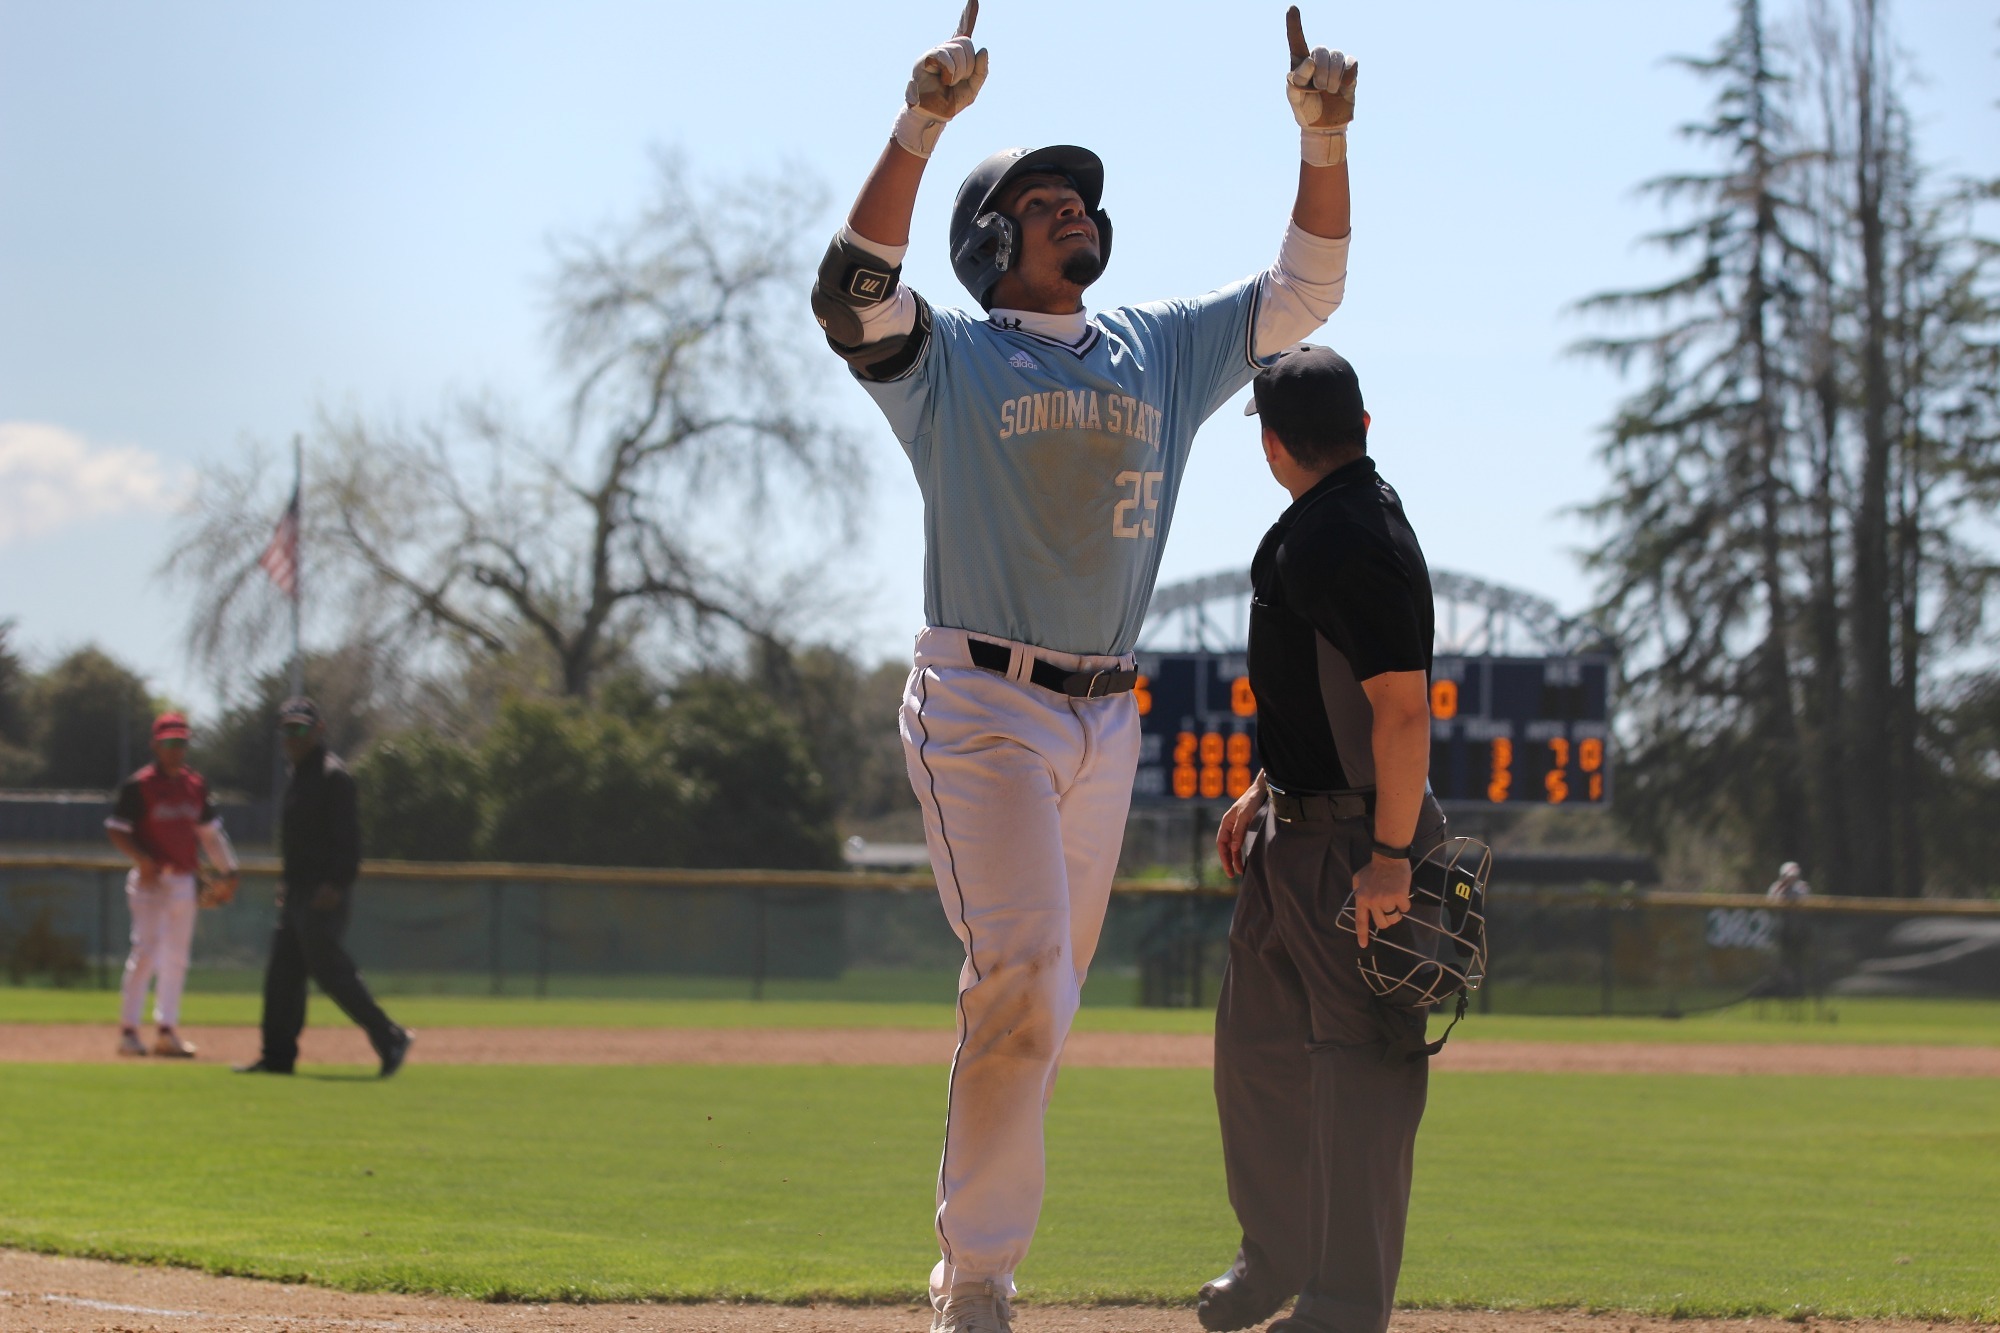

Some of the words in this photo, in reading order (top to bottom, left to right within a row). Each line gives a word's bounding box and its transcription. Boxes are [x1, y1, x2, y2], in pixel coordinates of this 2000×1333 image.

[1000, 390, 1102, 440] SONOMA
[1107, 393, 1164, 452] STATE
[1113, 470, 1164, 538] 25
[1431, 679, 1458, 720] 0
